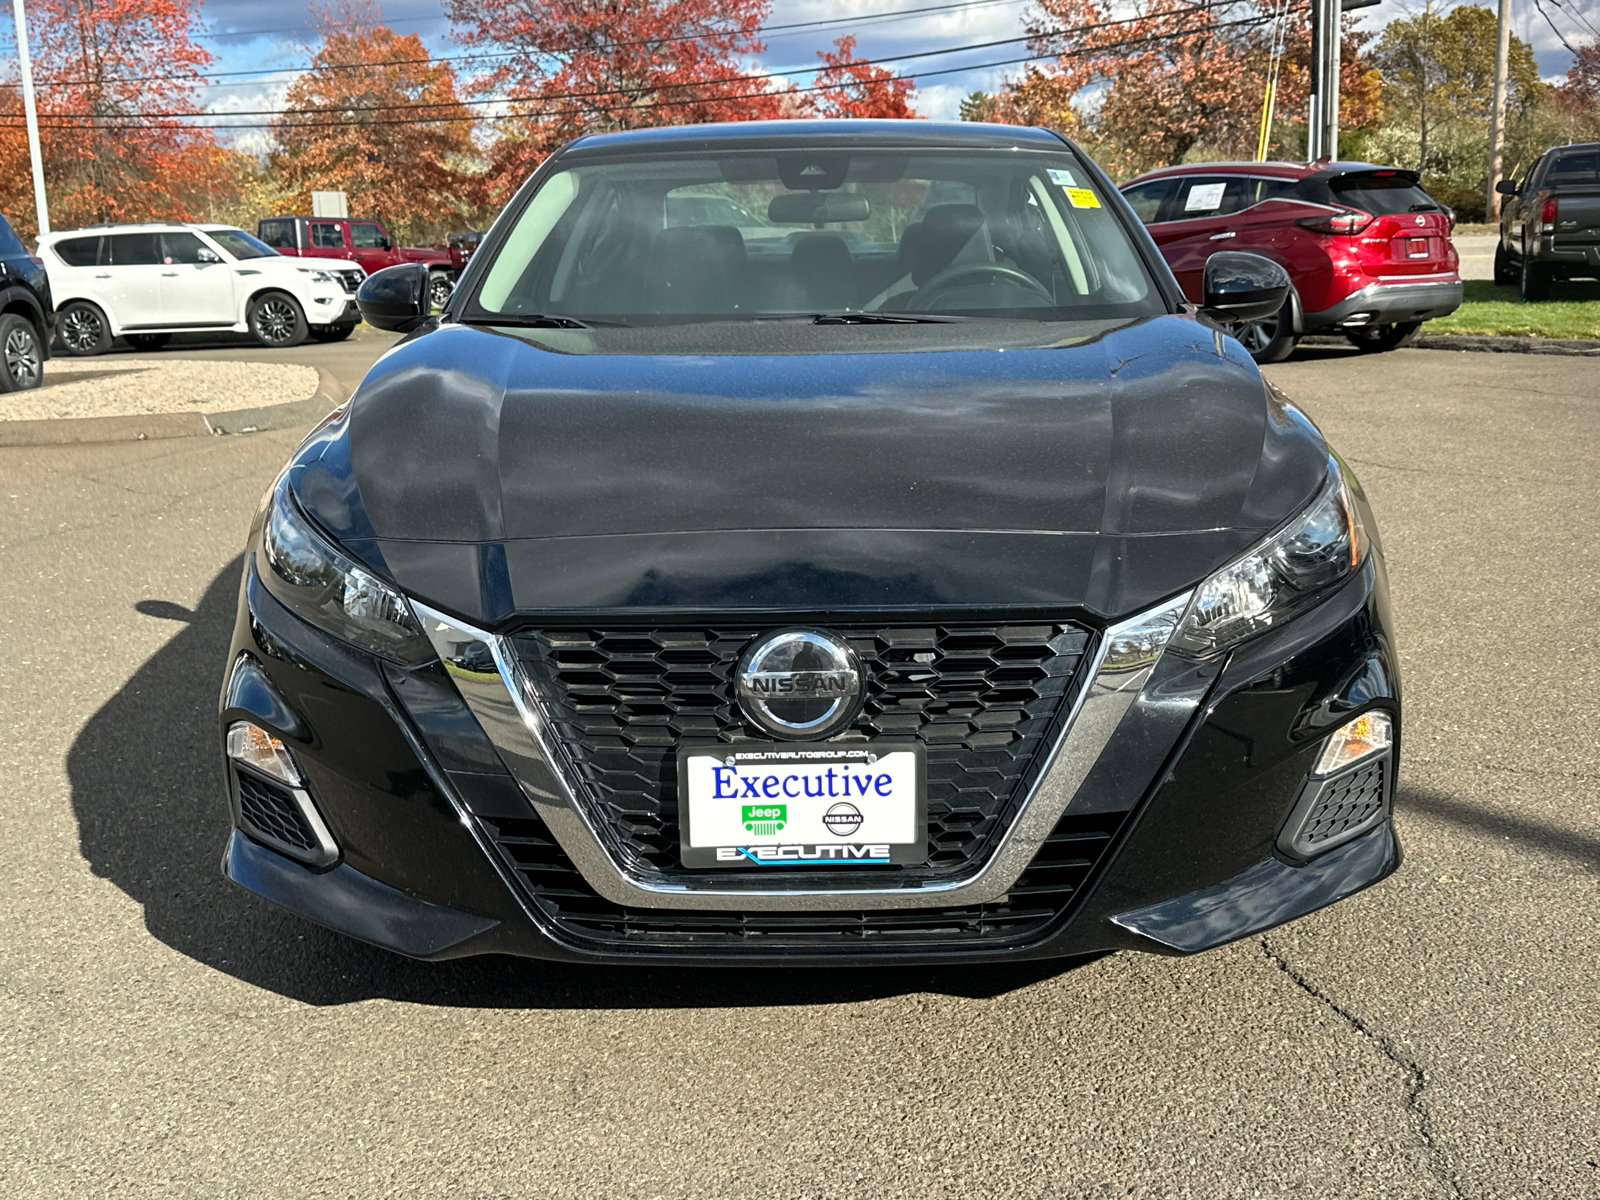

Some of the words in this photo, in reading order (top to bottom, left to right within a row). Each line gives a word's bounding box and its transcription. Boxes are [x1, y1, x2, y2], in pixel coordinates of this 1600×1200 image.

[752, 675, 847, 694] NISSAN
[735, 750, 869, 760] EXECUTIVEAUTOGROUP.COM
[711, 765, 893, 799] Executive
[748, 806, 781, 818] Jeep
[825, 815, 862, 823] NISSAN
[716, 844, 890, 861] EXECUTIVE
